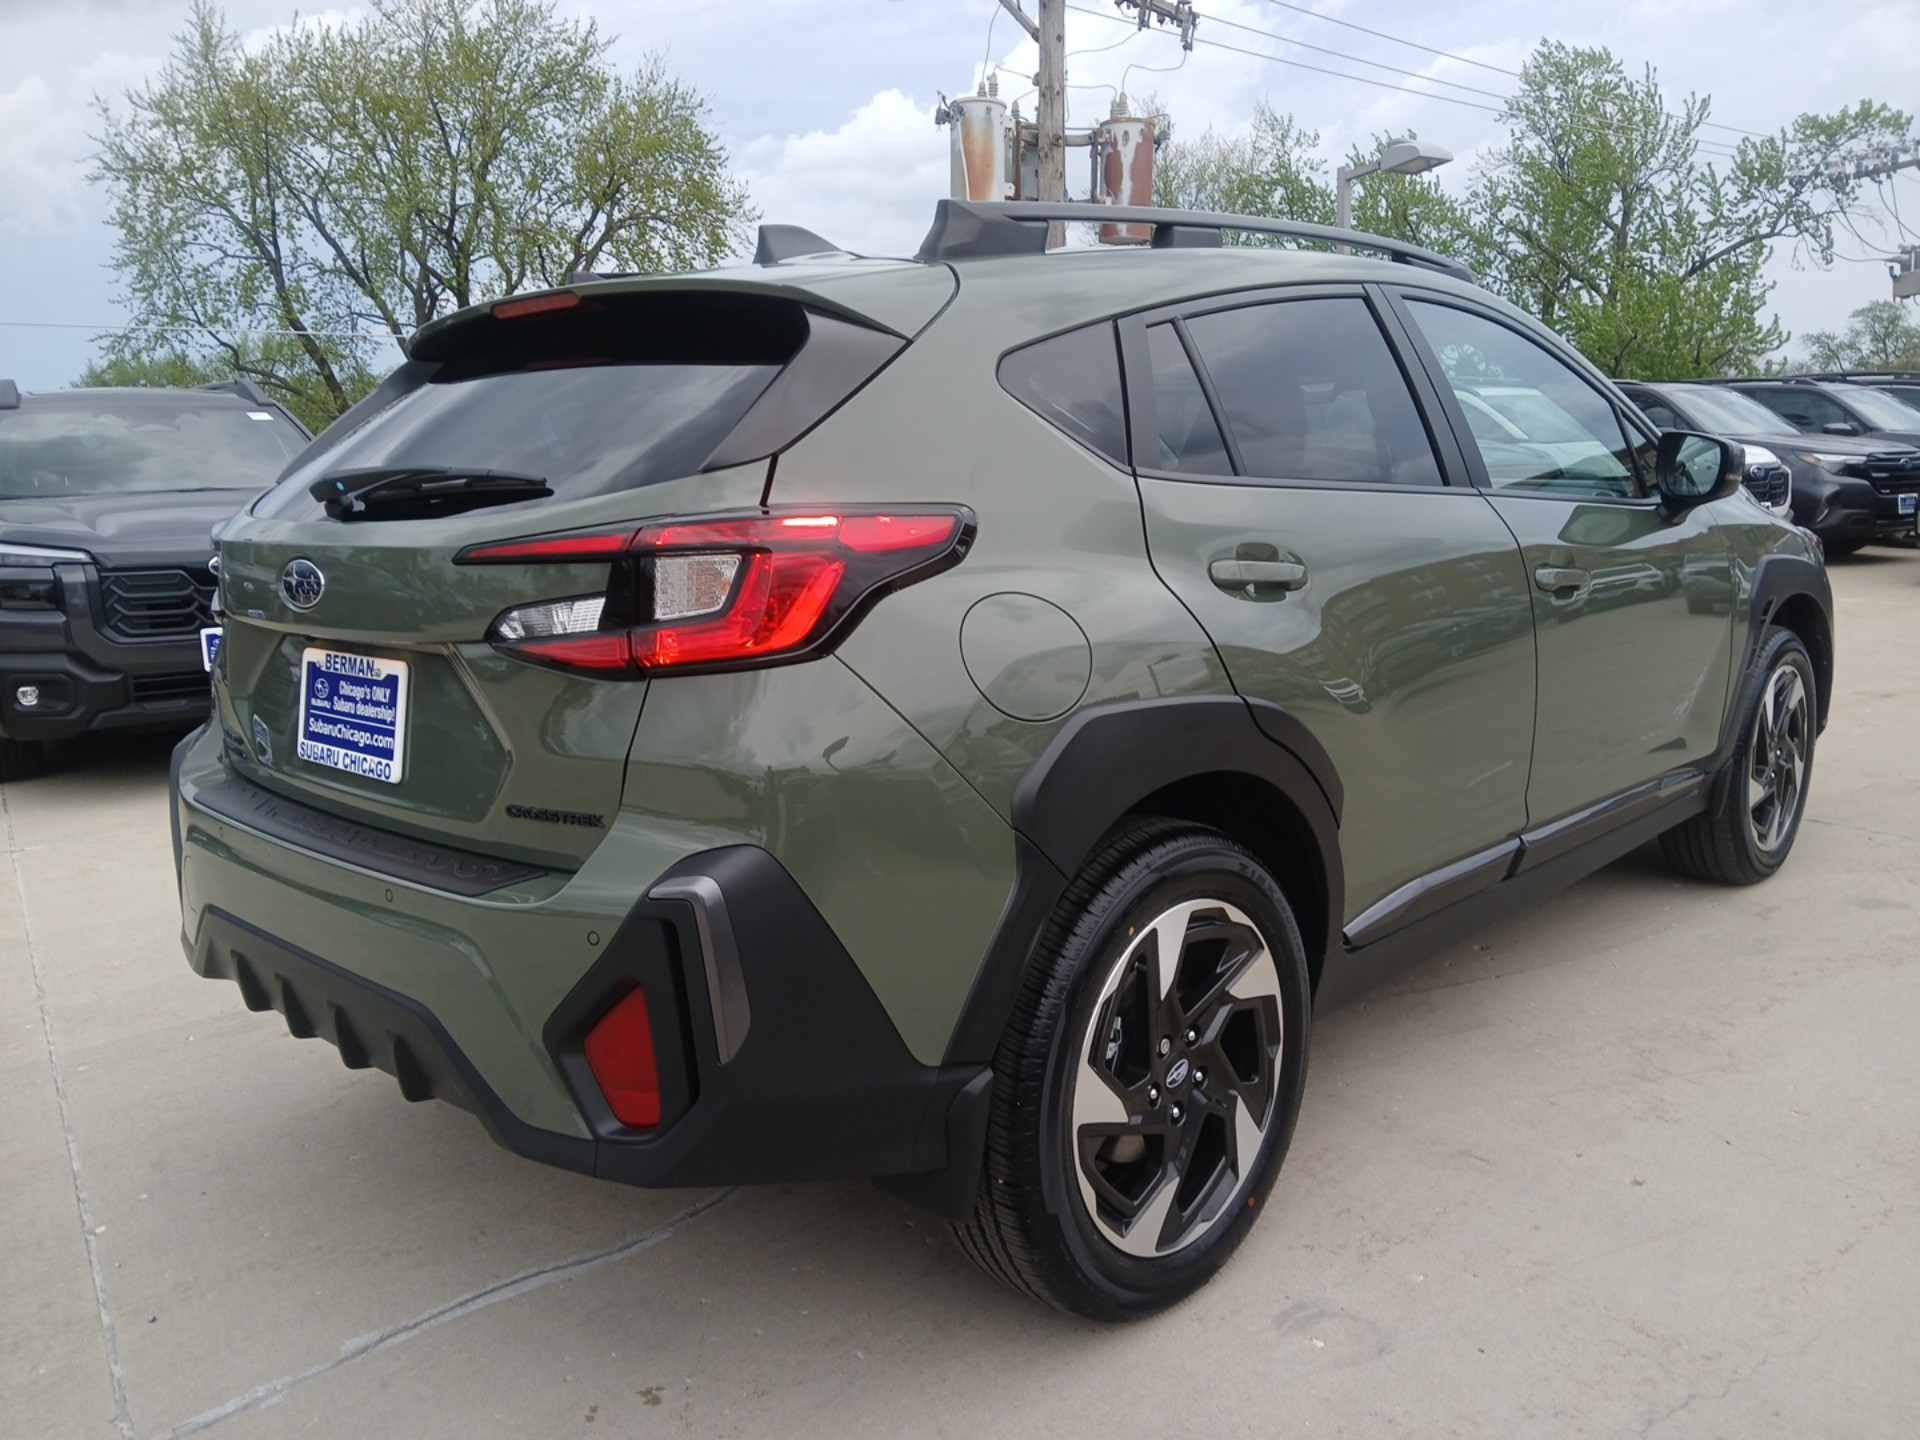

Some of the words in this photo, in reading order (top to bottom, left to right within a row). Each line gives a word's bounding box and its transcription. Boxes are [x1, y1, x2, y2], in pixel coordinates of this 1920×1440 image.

[325, 653, 375, 678] BERMAN
[339, 680, 371, 700] Chicago's
[371, 685, 391, 703] ONLY
[333, 696, 356, 714] Subaru
[356, 701, 395, 724] dealership!
[308, 717, 394, 750] SubaruChicago.com
[299, 741, 340, 766] SUBARU
[342, 752, 392, 780] CHICAGO
[505, 804, 605, 829] CROSSTREK
